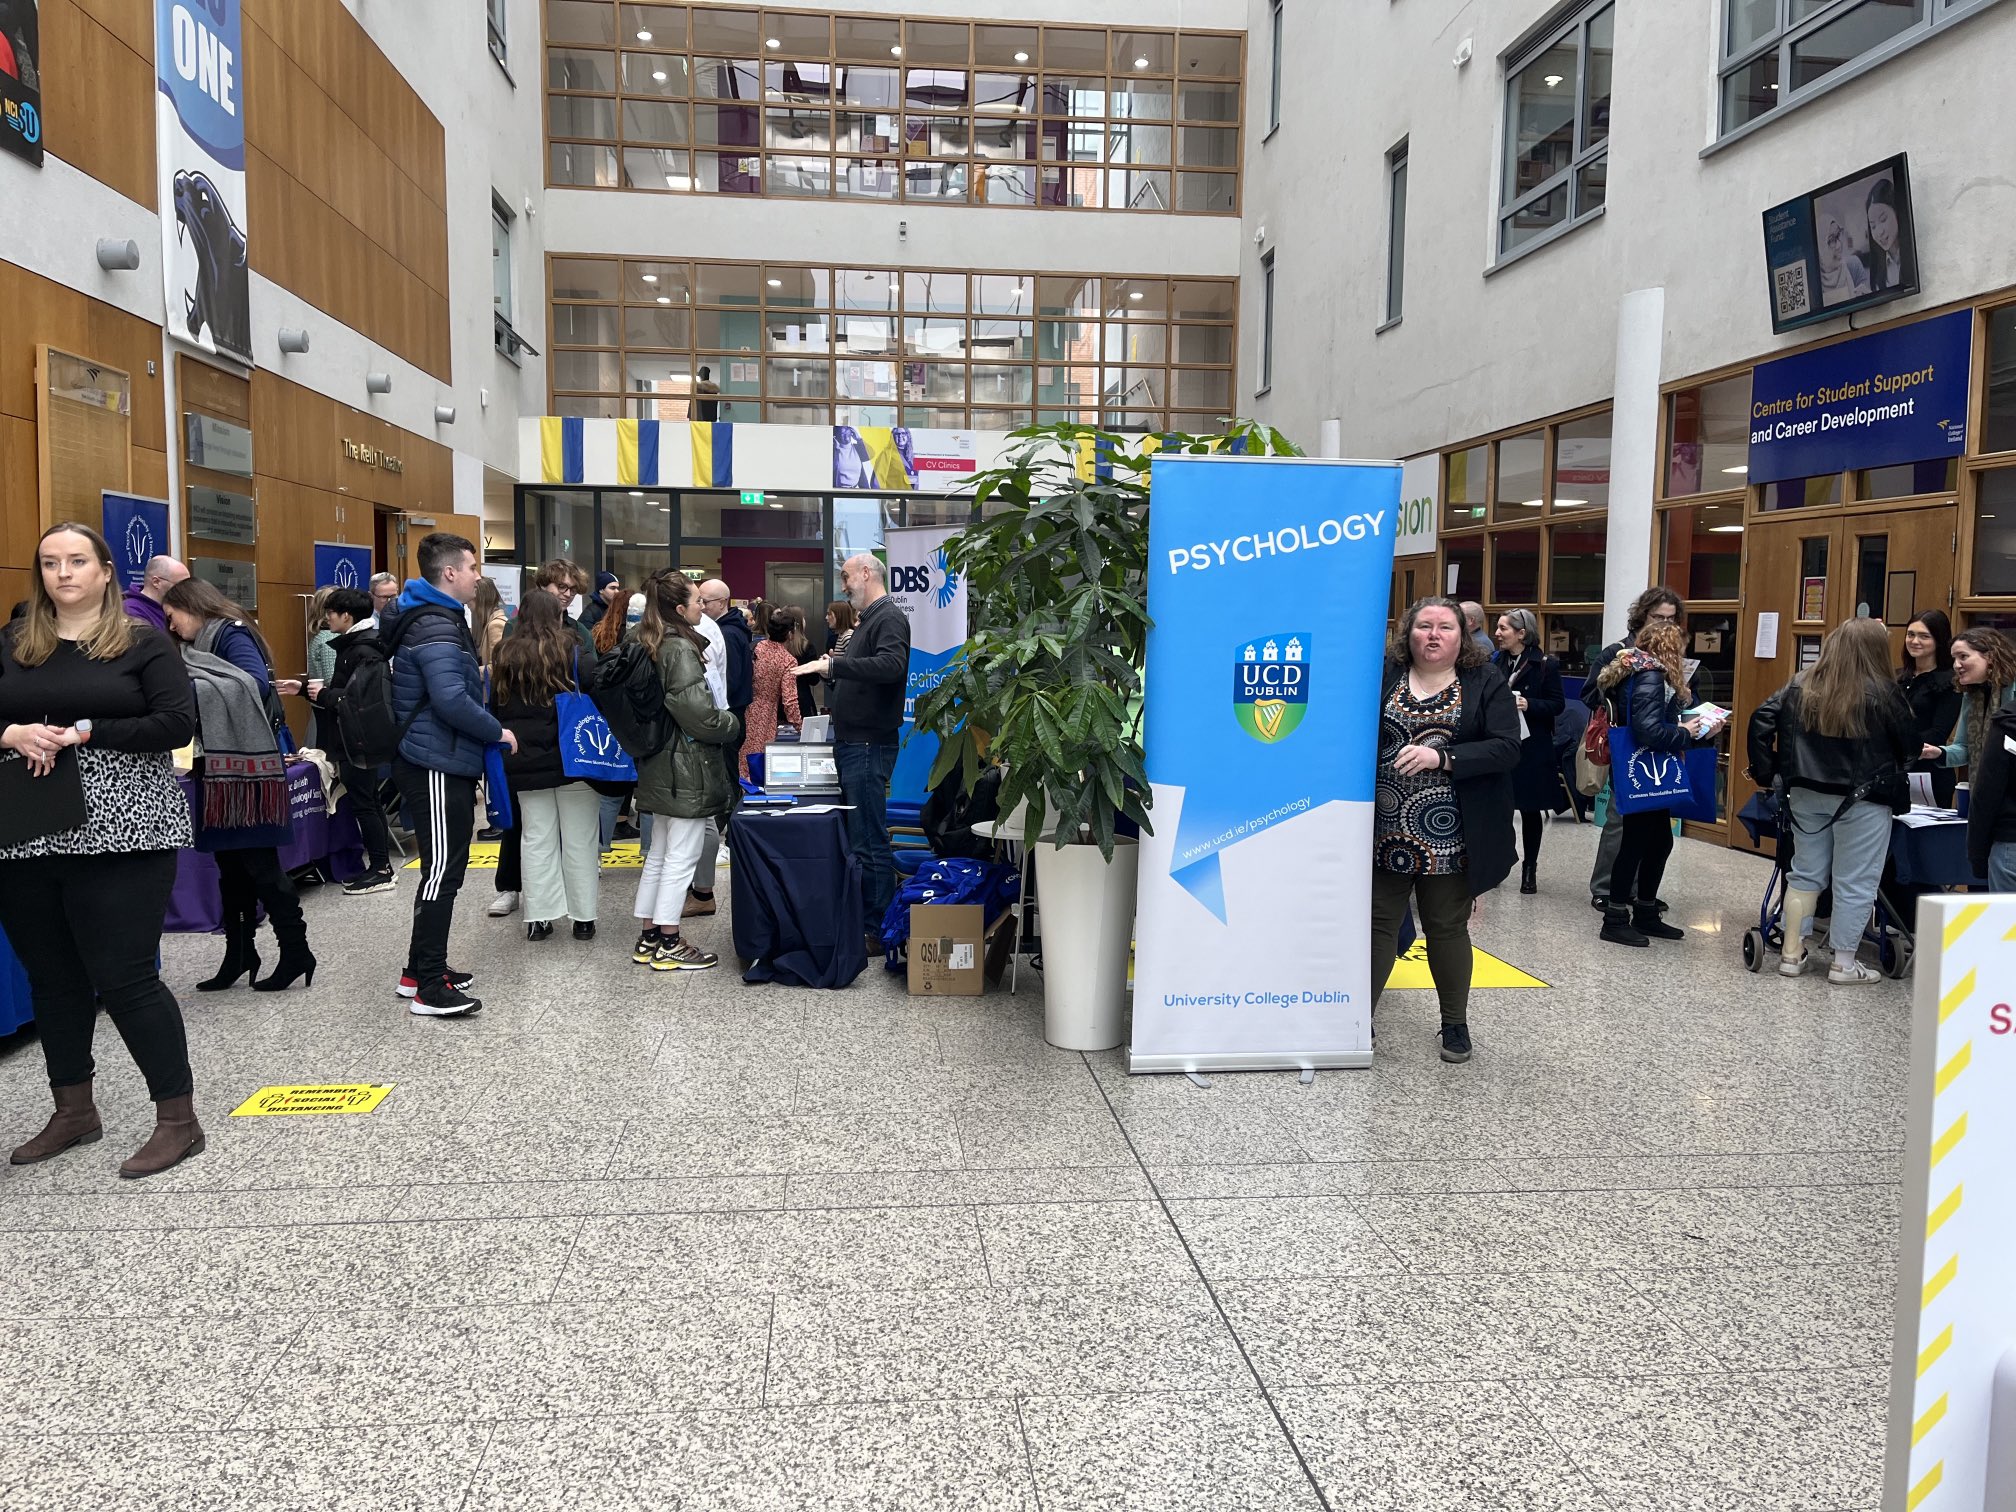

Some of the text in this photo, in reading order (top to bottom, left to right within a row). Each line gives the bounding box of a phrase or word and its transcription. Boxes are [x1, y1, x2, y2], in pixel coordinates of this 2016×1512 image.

[173, 4, 235, 117] ONE
[4, 97, 18, 119] NCI
[1753, 364, 1934, 418] Centre for Student Support
[1751, 398, 1915, 444] and Career Development
[342, 438, 358, 460] The
[925, 460, 960, 471] CV Clinics
[1168, 510, 1385, 575] PSYCHOLOGY
[890, 565, 930, 593] DBS
[1243, 664, 1302, 685] UCD
[1244, 686, 1298, 696] DUBLIN
[577, 743, 587, 756] The
[1631, 777, 1642, 790] The
[1182, 796, 1311, 859] www.ucd.ie/psychology
[1164, 991, 1350, 1008] University College Dublin
